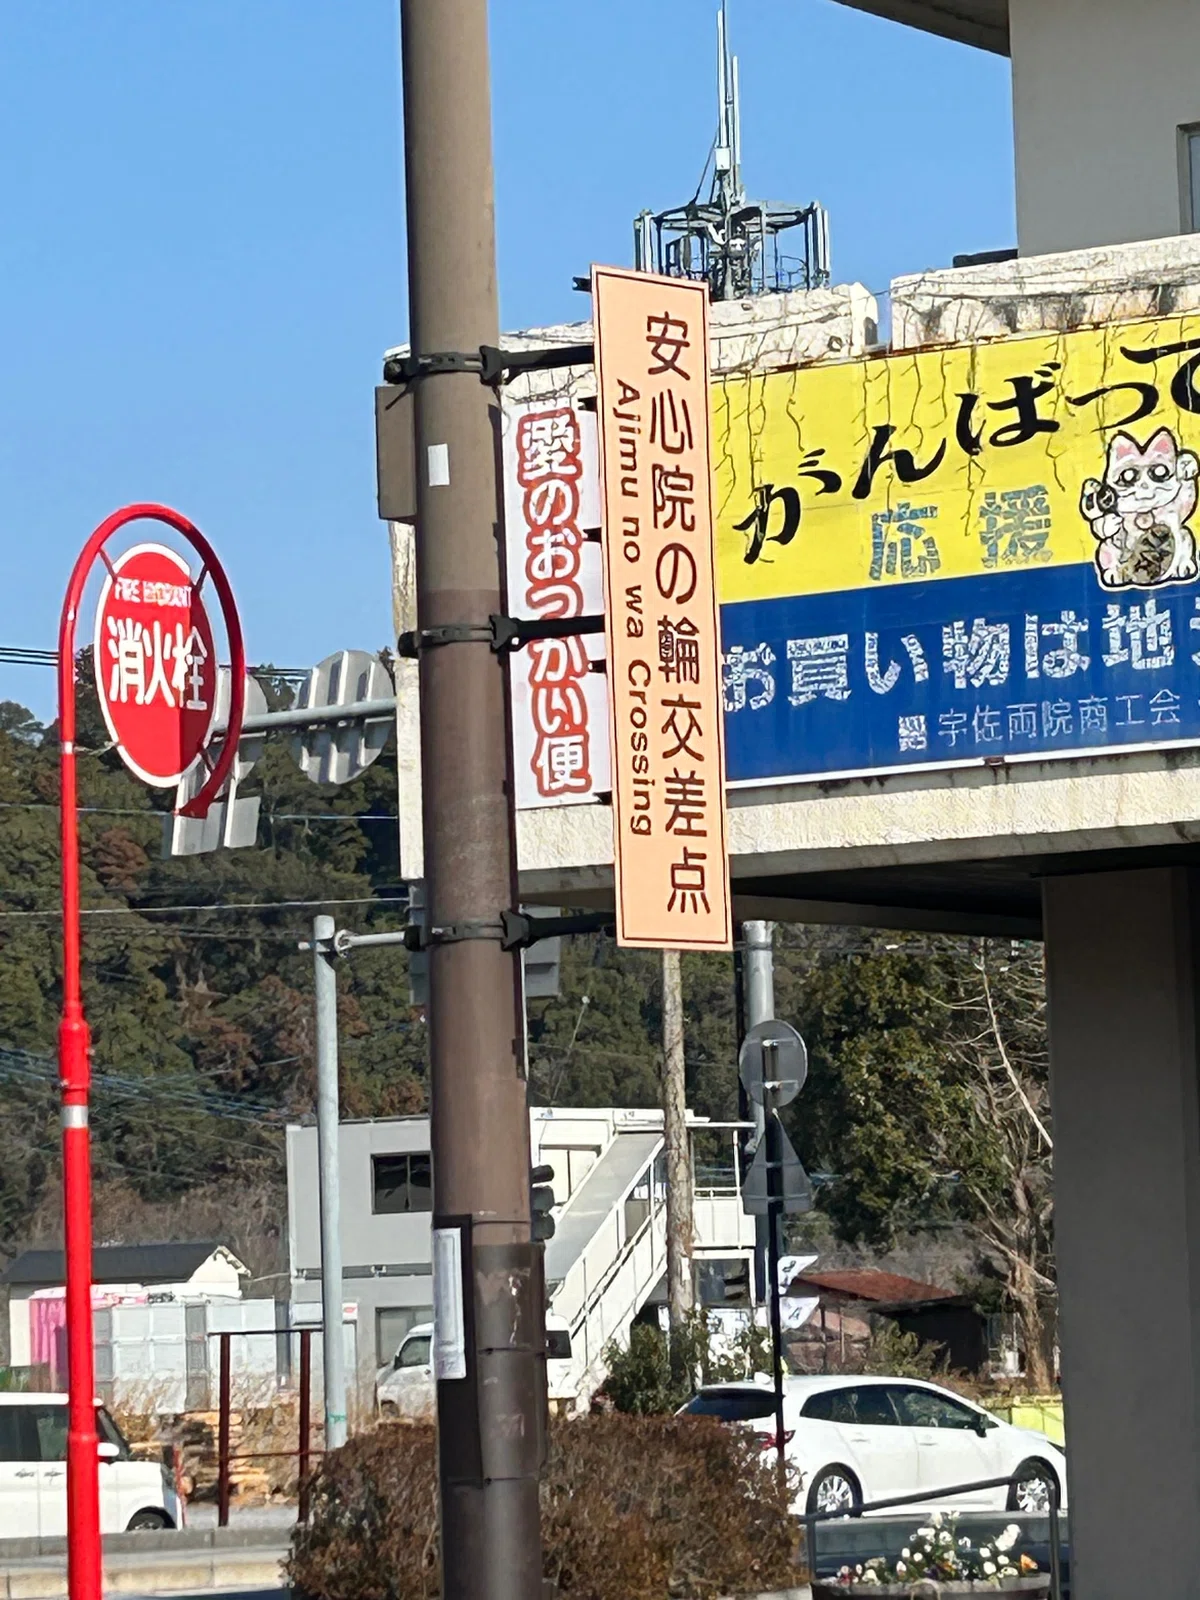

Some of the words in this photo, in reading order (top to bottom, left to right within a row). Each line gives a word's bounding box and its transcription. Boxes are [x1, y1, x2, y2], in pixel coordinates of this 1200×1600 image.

[613, 378, 641, 498] Ajimu
[622, 516, 641, 564] no
[869, 484, 1053, 581] 応援
[518, 408, 591, 795] 愛のおつかい便
[625, 585, 644, 639] wa
[645, 310, 711, 914] 安心院の輪交差点
[722, 597, 1200, 712] お買い物は地
[107, 615, 208, 711] 消火栓
[628, 659, 655, 836] Crossing
[937, 688, 1181, 747] 宇佐両院商工会
